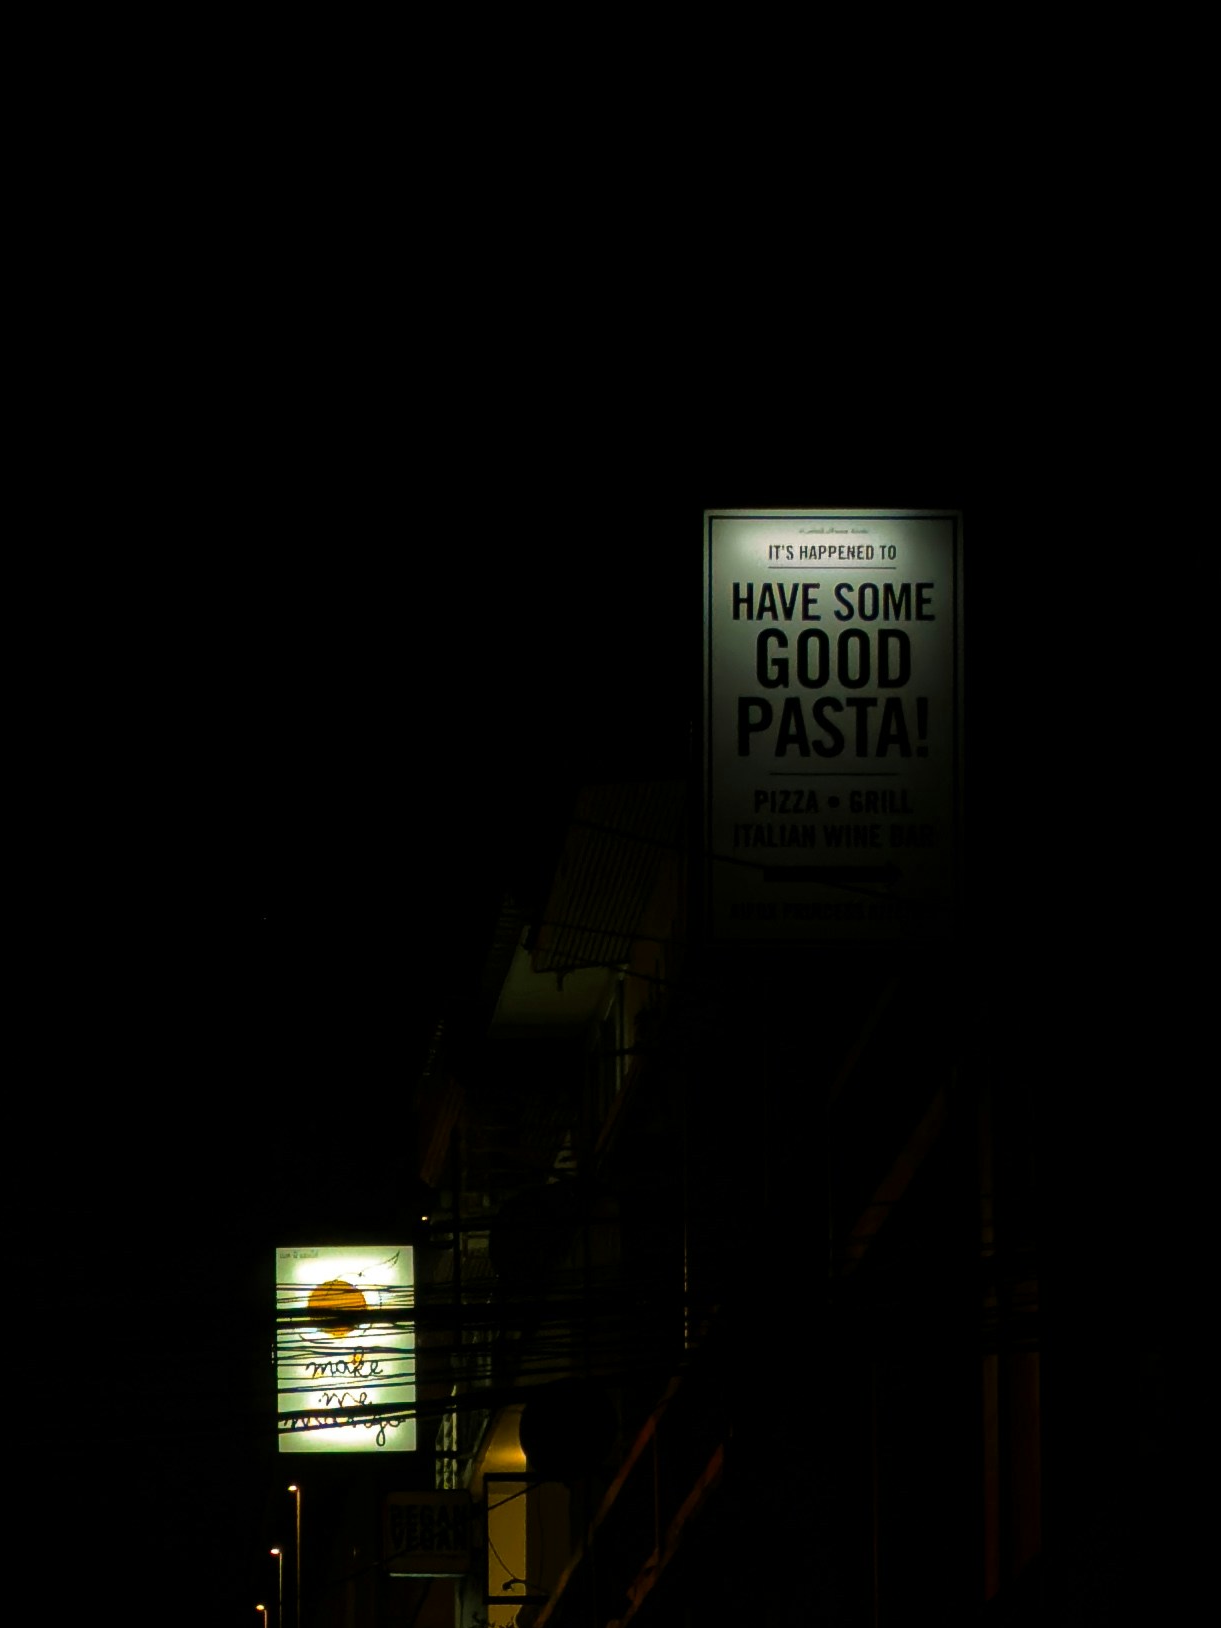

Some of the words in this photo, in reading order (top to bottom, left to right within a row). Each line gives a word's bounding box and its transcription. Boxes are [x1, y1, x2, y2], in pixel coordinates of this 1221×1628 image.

[768, 544, 794, 561] IT'S
[799, 544, 875, 561] HAPPENED
[880, 544, 897, 561] TO
[732, 582, 821, 621] HAVE
[834, 582, 935, 621] SOME
[756, 628, 911, 689] GOOD
[737, 696, 929, 758] PASTA!
[754, 790, 819, 814] PIZZA
[850, 790, 914, 814] GRILL
[733, 824, 816, 848] ITALIAN
[824, 824, 882, 848] WINE
[890, 824, 934, 848] BAR
[305, 1346, 384, 1379] make
